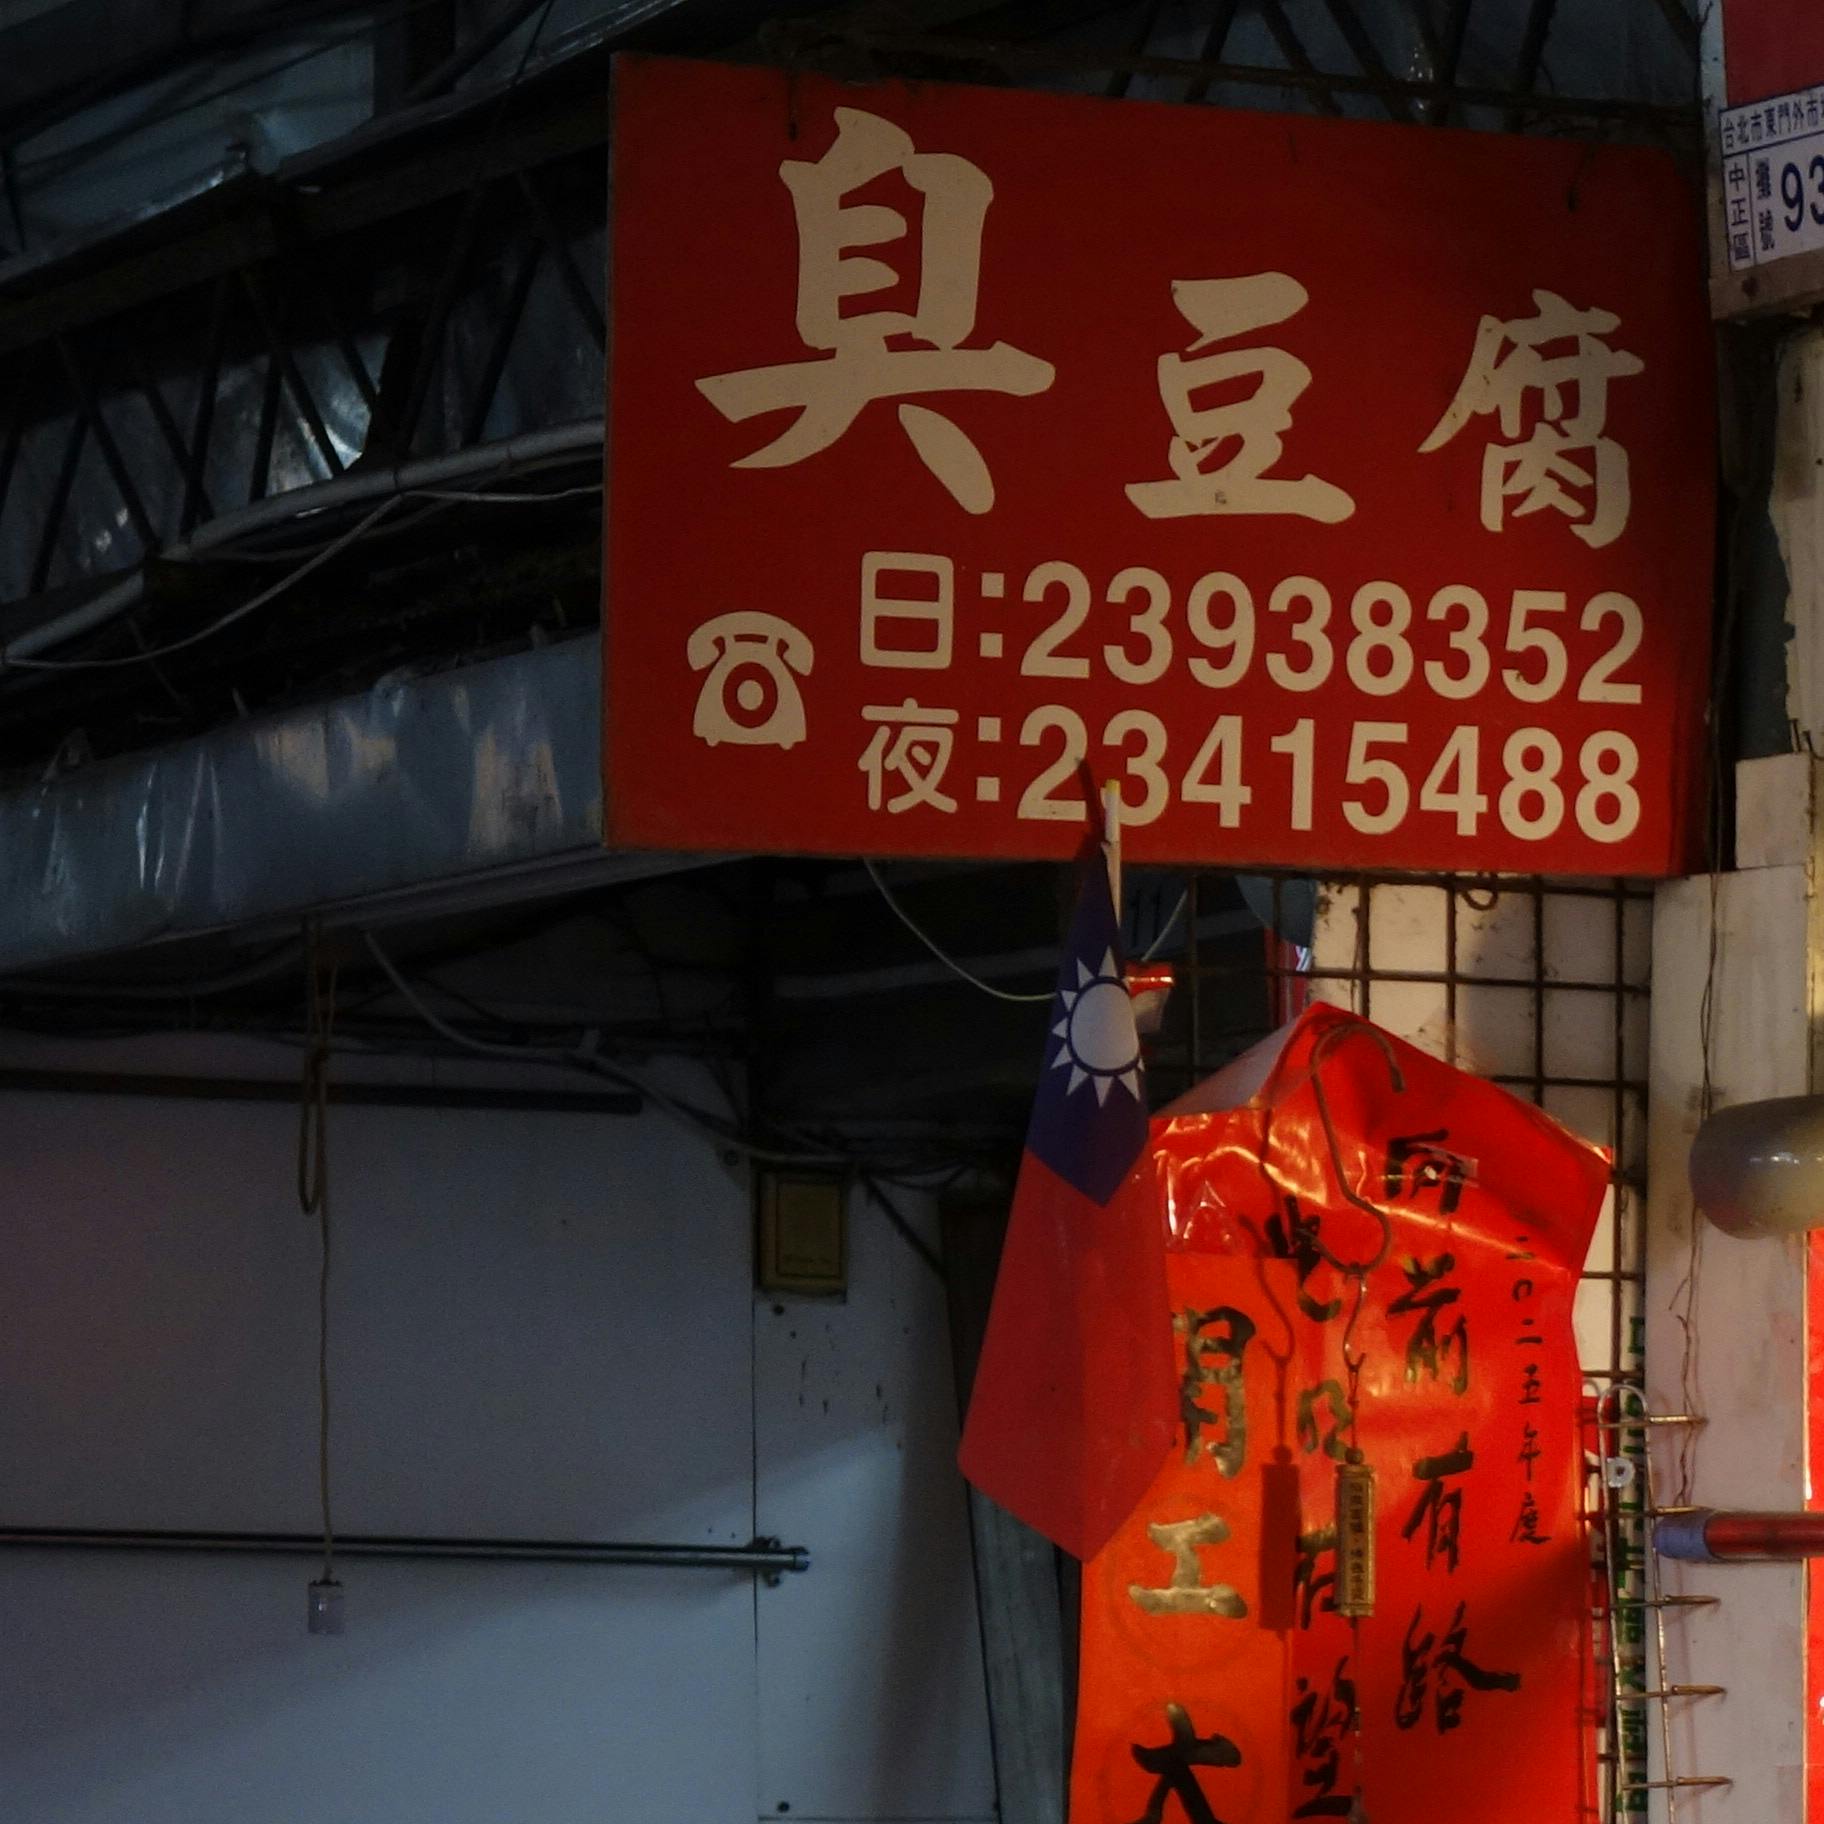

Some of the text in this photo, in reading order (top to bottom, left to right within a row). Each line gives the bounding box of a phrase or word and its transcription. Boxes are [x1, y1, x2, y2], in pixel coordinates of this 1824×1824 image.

[695, 105, 1644, 549] 臭豆腐
[1729, 162, 1750, 261] 中正區
